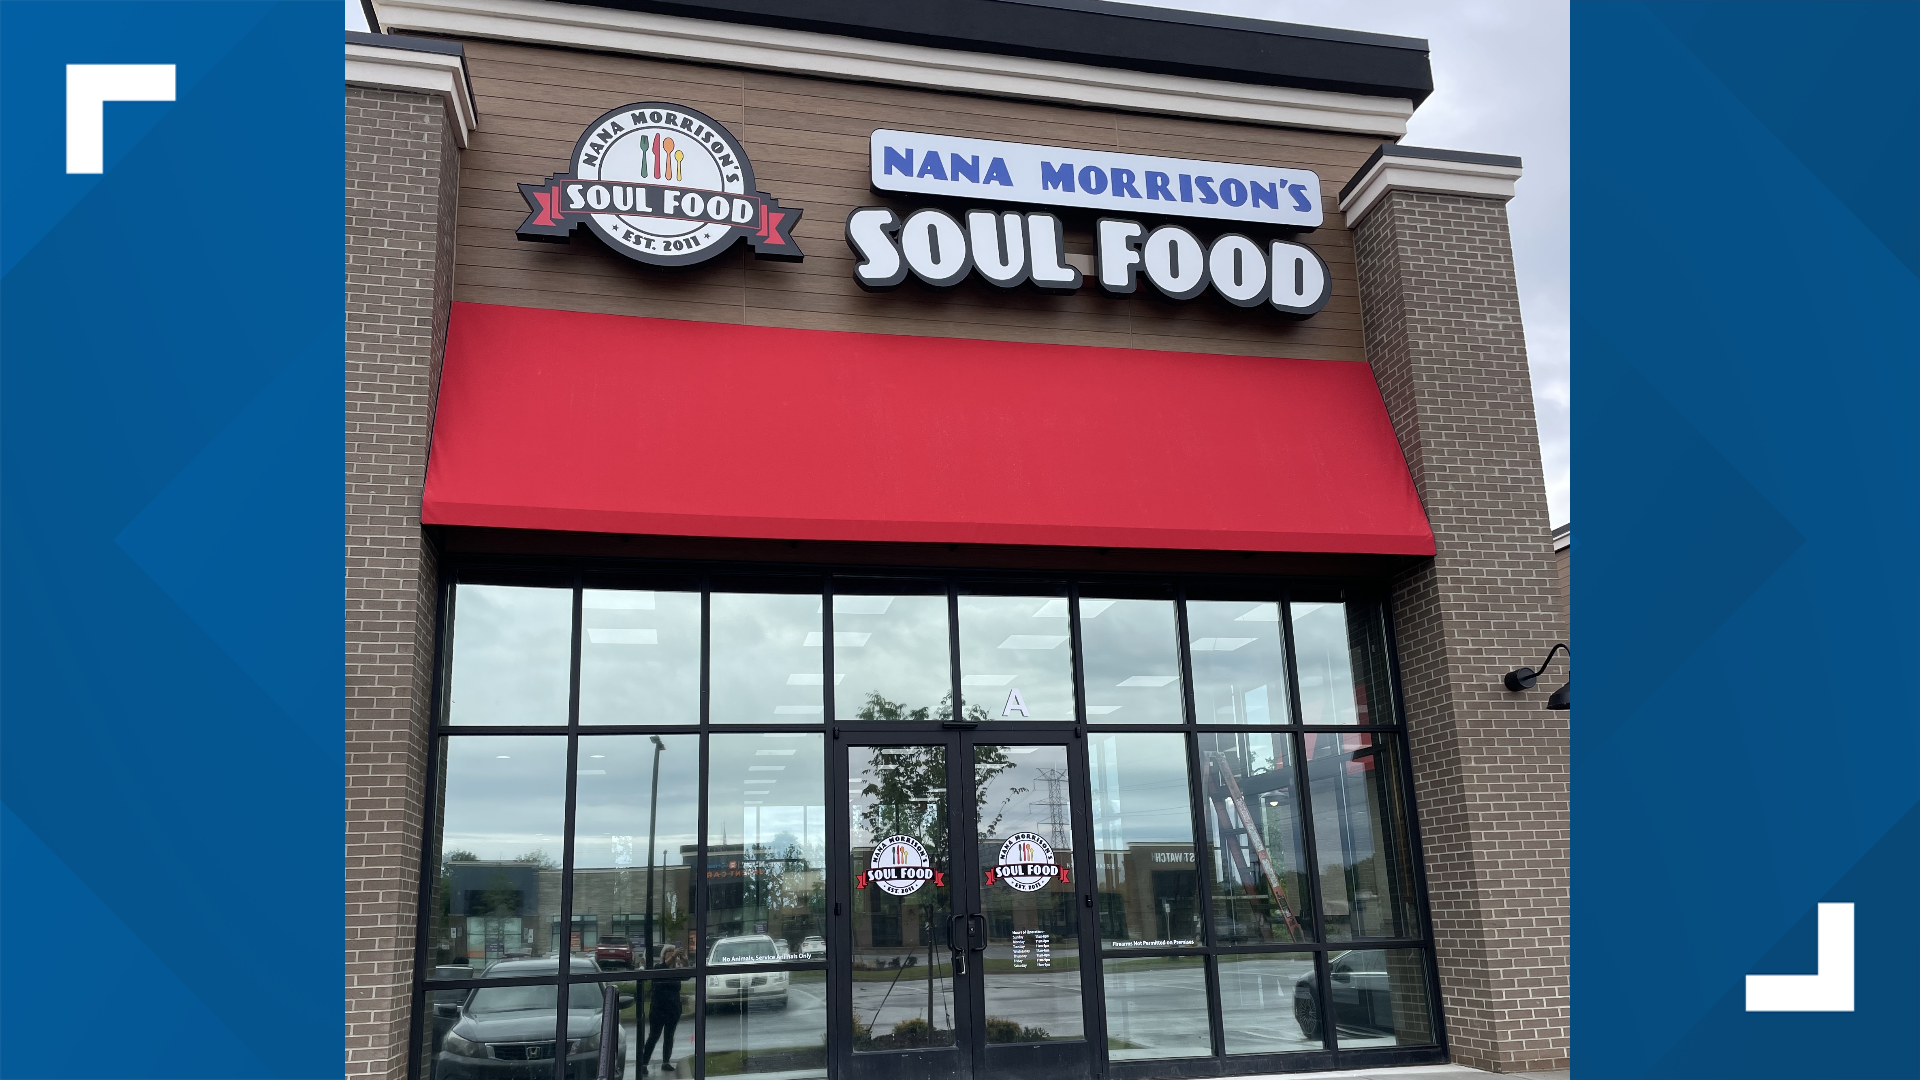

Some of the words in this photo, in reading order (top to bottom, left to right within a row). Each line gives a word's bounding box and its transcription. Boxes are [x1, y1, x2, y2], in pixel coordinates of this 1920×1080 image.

[582, 120, 626, 168] NANA
[630, 111, 740, 183] MORRISON'S
[883, 145, 1014, 187] NANA
[1040, 160, 1313, 213] MORRISON'S
[566, 184, 653, 213] SOUL
[663, 189, 754, 224] FOOD
[621, 229, 657, 251] EST.
[662, 235, 701, 252] 2011
[848, 208, 1077, 284] SOUL
[1099, 219, 1327, 310] FOOD
[1001, 687, 1030, 718] A
[873, 843, 888, 863] NANA
[1000, 840, 1014, 860] NANA
[867, 868, 898, 881] SOUL
[900, 867, 934, 880] FOOD
[995, 864, 1025, 878] SOUL
[1027, 864, 1059, 876] FOOD
[798, 952, 812, 960] Only
